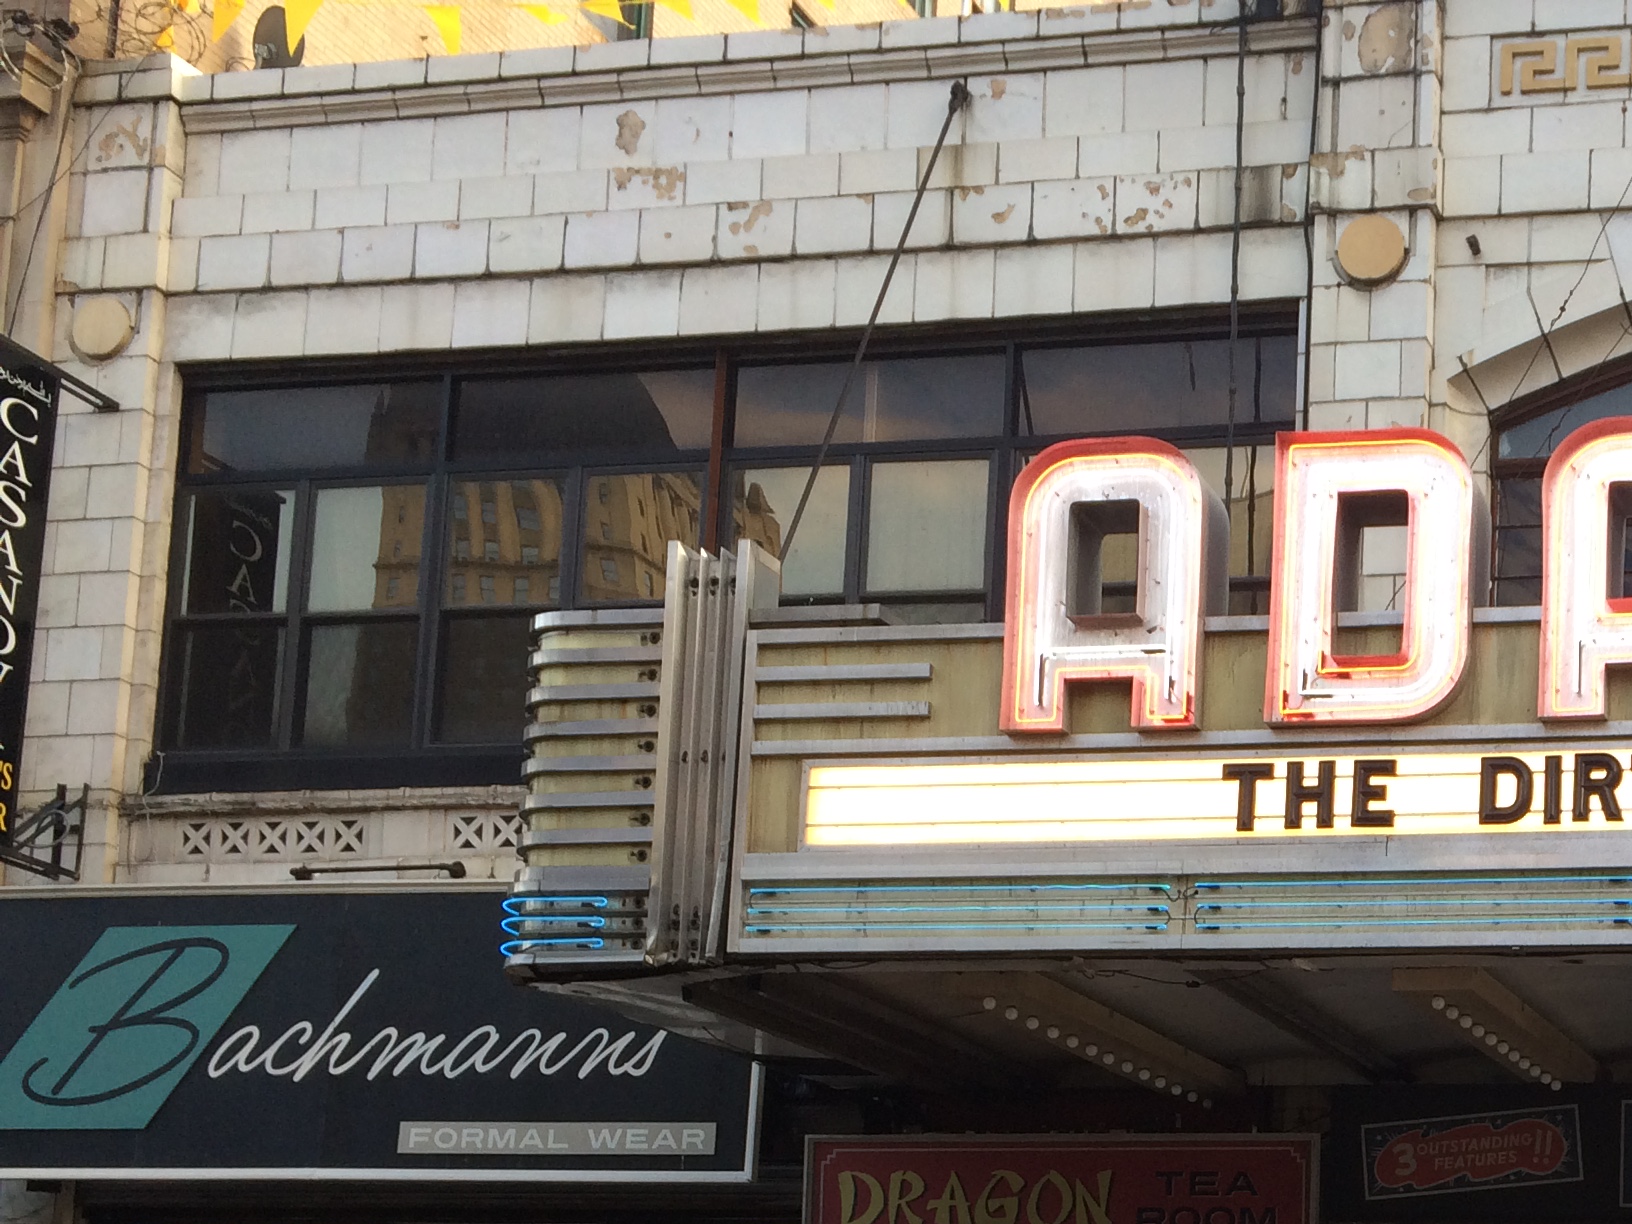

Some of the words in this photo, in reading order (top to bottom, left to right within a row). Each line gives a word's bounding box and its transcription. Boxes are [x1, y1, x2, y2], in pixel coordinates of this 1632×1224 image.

[1221, 758, 1396, 831] THE
[22, 937, 667, 1106] Bachmanns
[407, 1126, 569, 1150] FORMAL
[588, 1126, 706, 1150] WEAR
[1392, 1142, 1418, 1176] 3
[1416, 1132, 1534, 1156] OUTSTANDING
[1434, 1150, 1518, 1172] FEATURES
[1155, 1170, 1259, 1198] TEA
